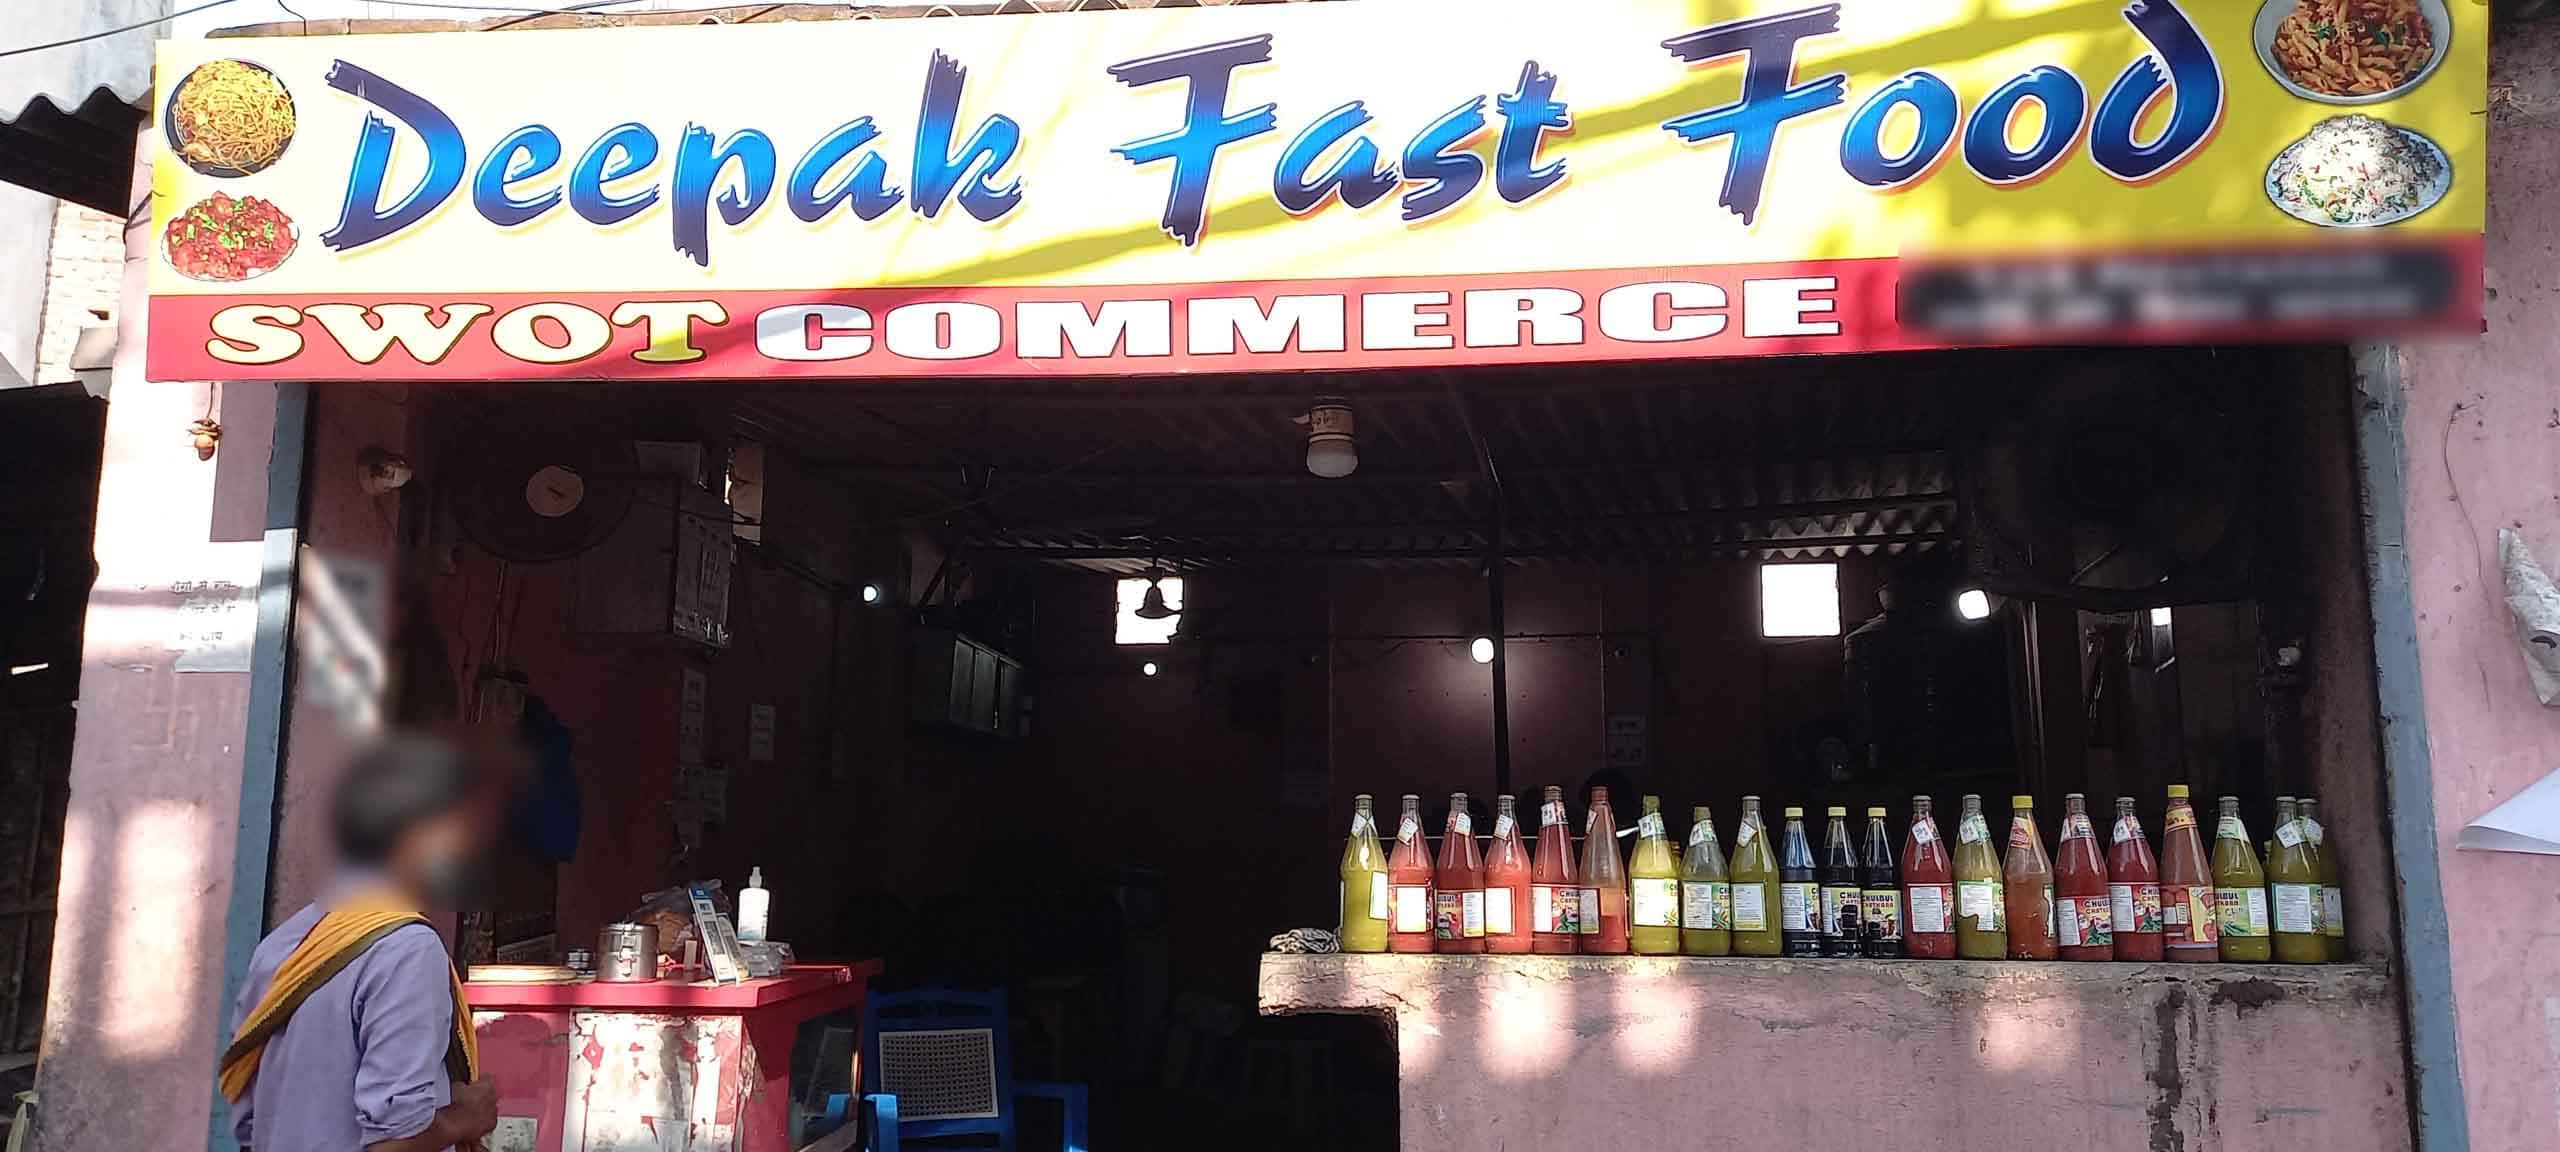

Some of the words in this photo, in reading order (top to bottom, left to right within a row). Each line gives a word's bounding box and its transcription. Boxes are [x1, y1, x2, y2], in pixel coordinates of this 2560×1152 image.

[318, 47, 1024, 268] Deepak
[1106, 32, 1572, 248] Fast
[1660, 0, 2223, 227] Food
[205, 301, 730, 366] SWOT
[756, 276, 1839, 361] COMMERCE
